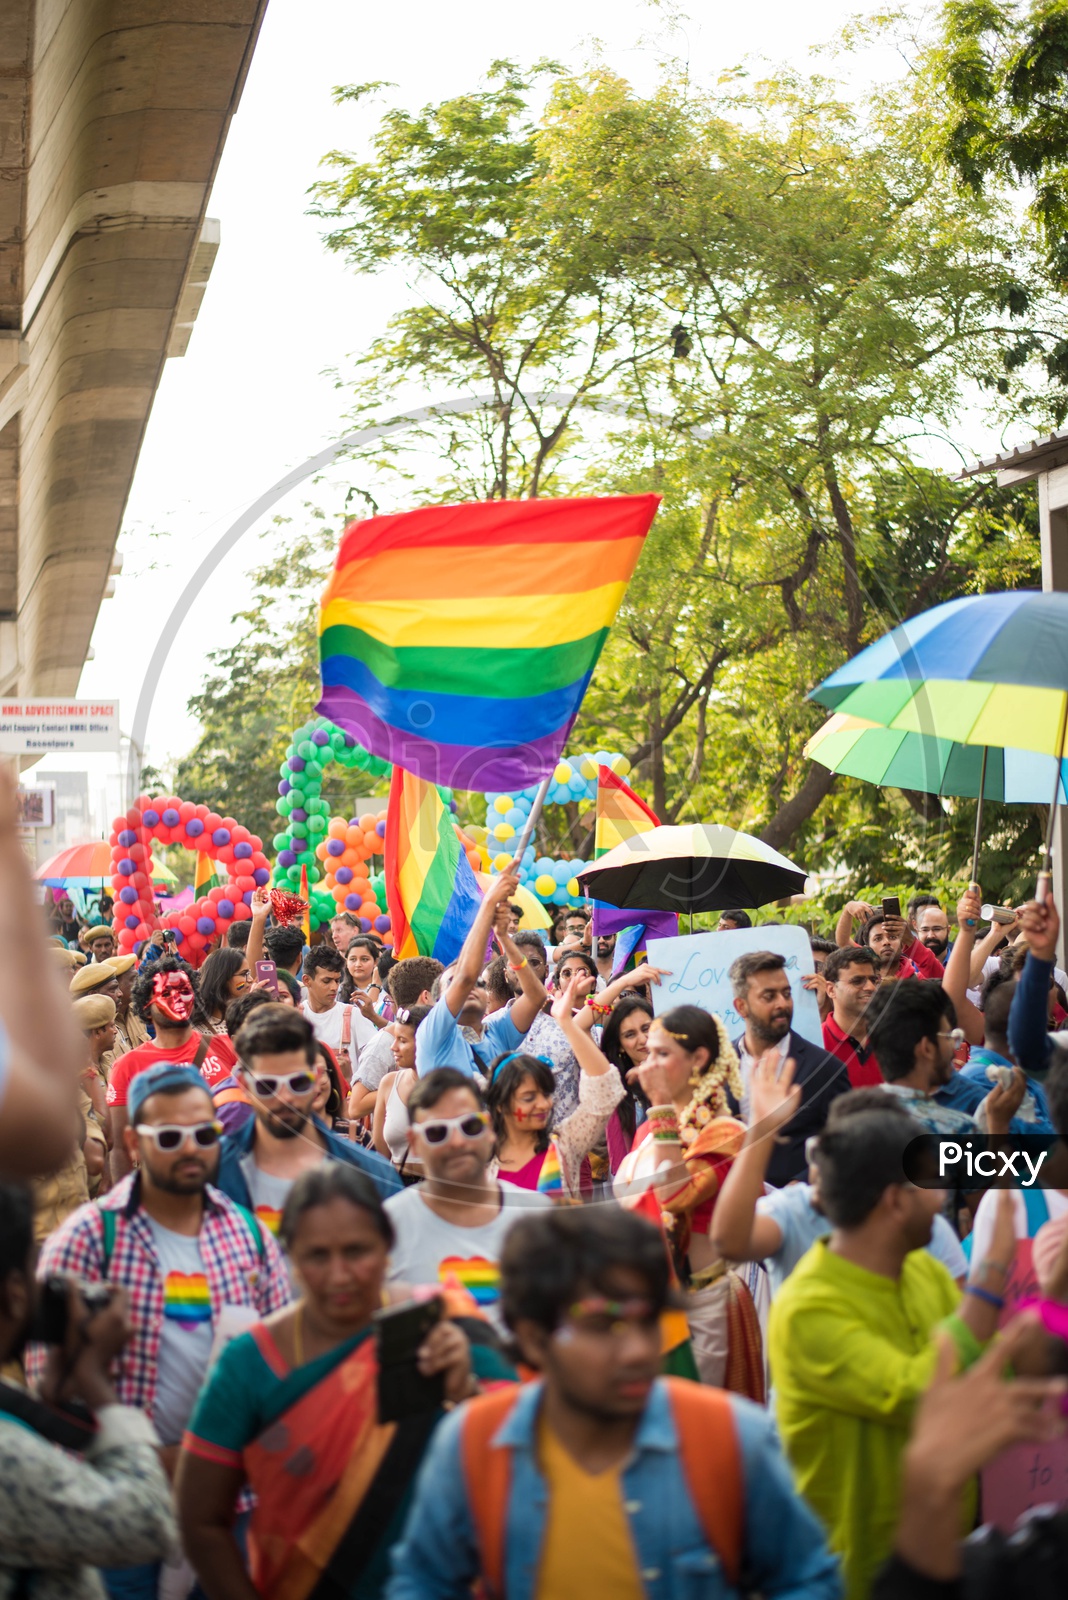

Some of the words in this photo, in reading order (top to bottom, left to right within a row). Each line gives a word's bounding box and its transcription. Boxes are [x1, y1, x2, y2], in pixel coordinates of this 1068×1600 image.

[25, 705, 88, 716] ADVERTISEMENT
[90, 705, 114, 716] SPACE
[42, 724, 68, 733] Contact
[90, 724, 108, 733] Office
[669, 952, 734, 993] Lov
